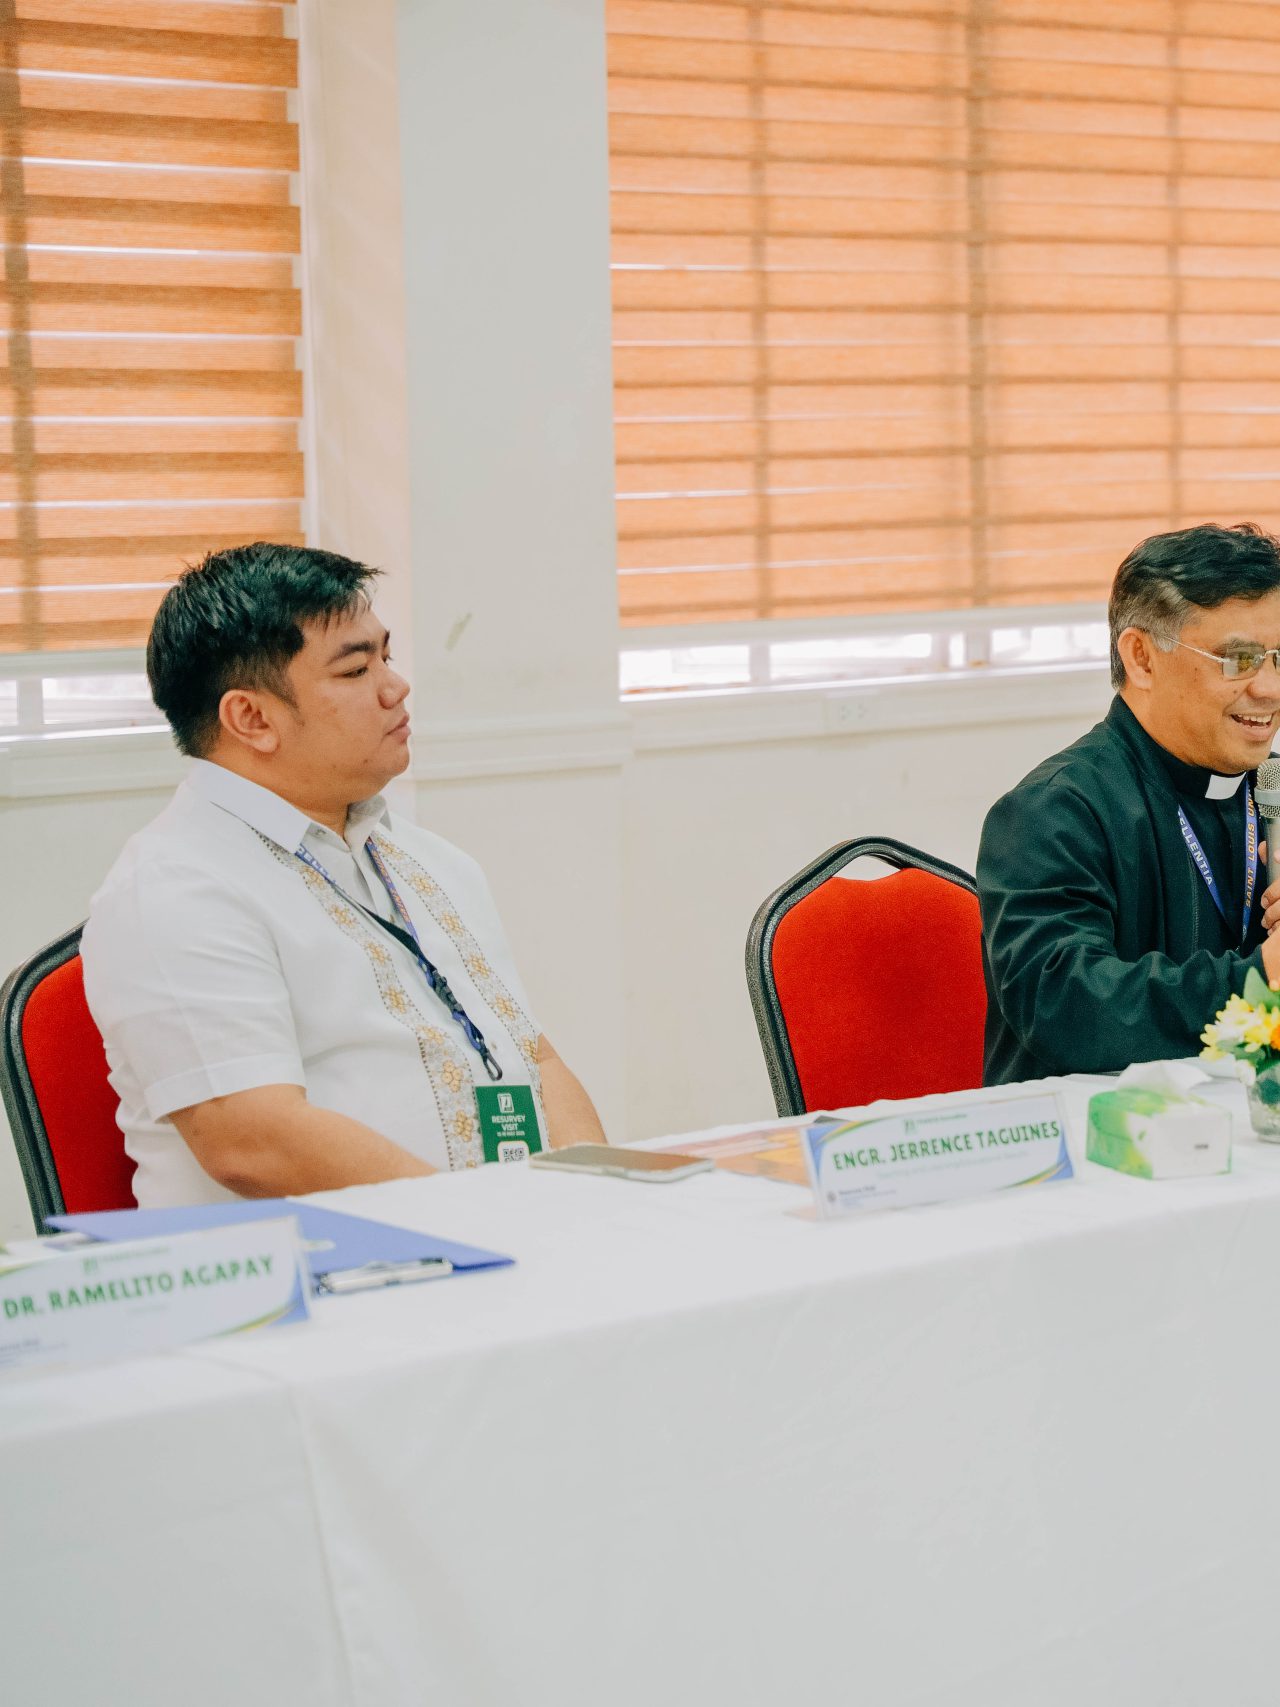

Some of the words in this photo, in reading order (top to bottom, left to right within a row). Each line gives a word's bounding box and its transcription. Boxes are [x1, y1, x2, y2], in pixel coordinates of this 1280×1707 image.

[1178, 811, 1213, 885] ELLENTIA
[1247, 823, 1256, 861] LOUIS
[1245, 867, 1256, 907] SAINT
[491, 1114, 526, 1123] RESURVEY
[501, 1123, 519, 1131] VISIT
[833, 1148, 887, 1171] ENGR.
[889, 1133, 973, 1163] JERRENCE
[976, 1120, 1060, 1148] TAGUINES
[3, 1296, 44, 1319] DR.
[48, 1272, 174, 1312] RAMELITO
[181, 1255, 273, 1288] AGAPAY
